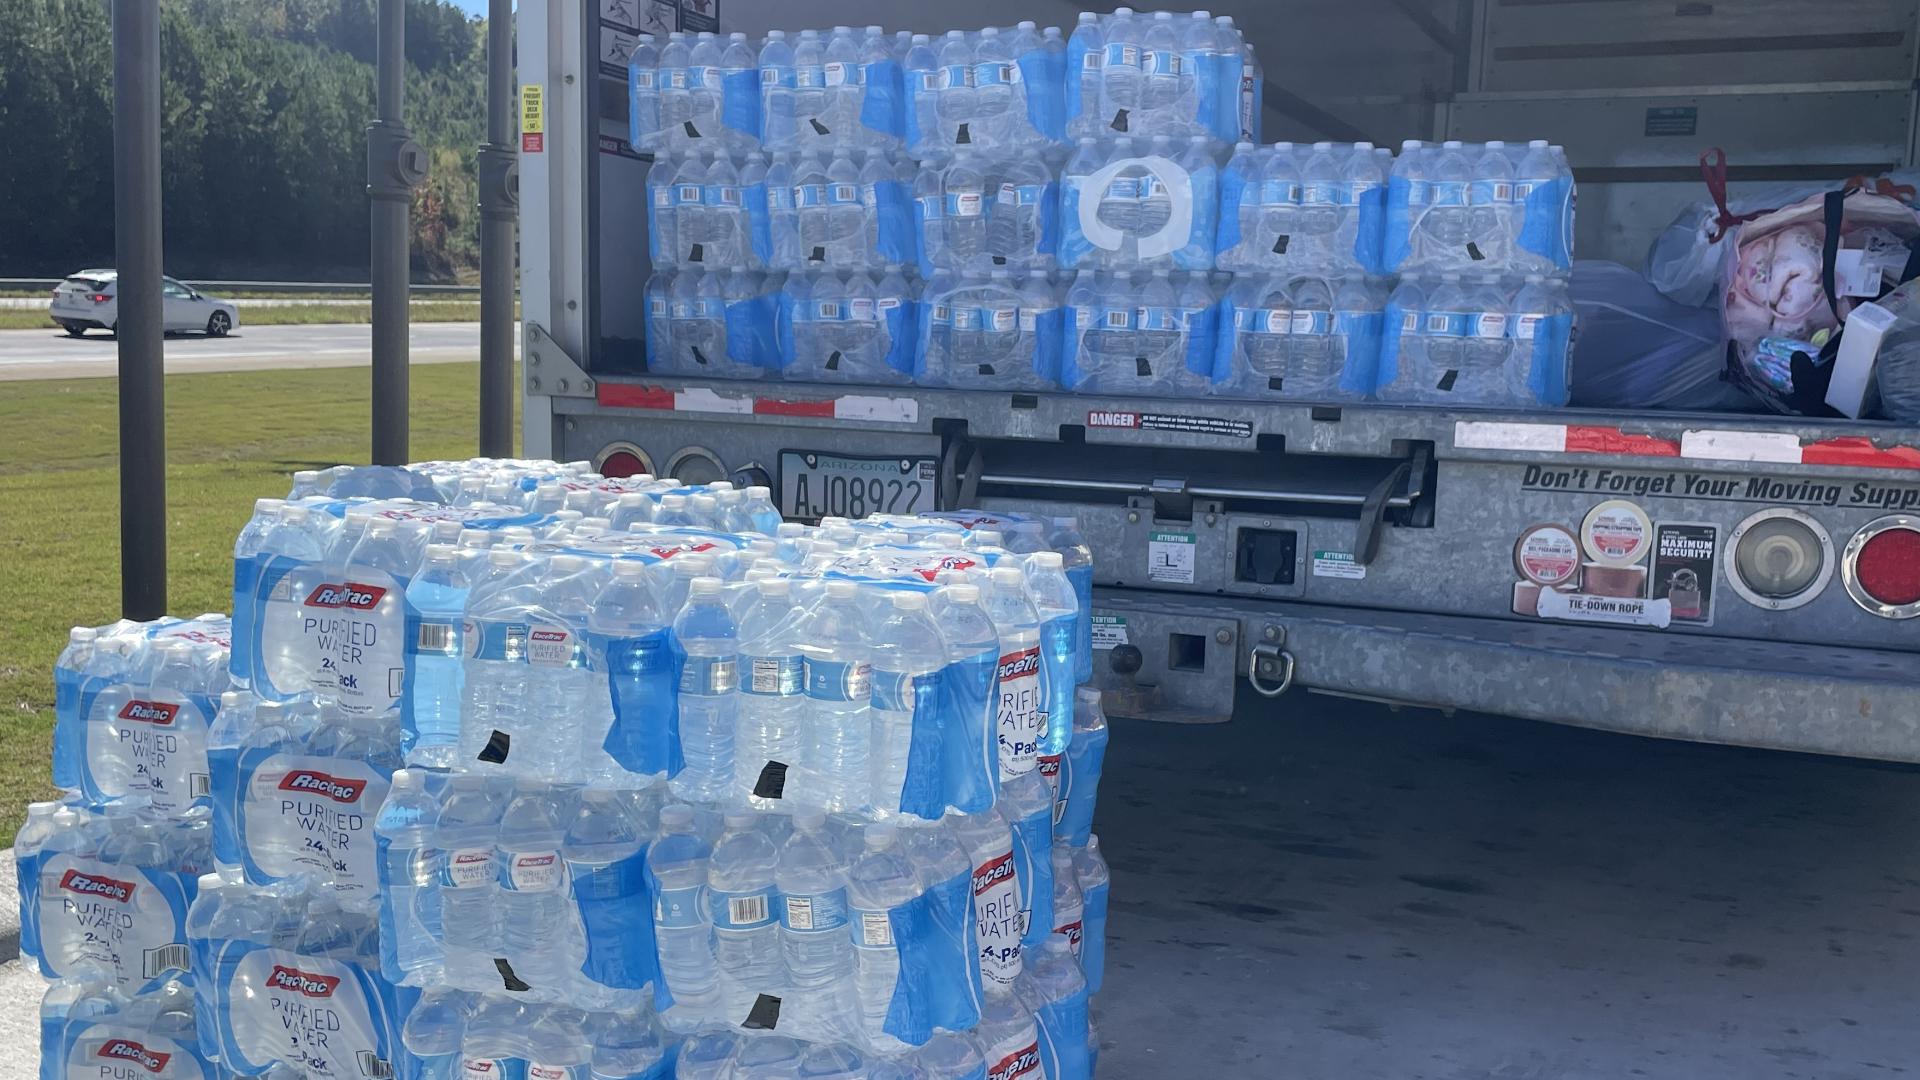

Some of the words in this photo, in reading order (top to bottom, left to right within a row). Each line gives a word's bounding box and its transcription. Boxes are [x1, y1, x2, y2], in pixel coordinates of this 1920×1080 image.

[1090, 412, 1135, 427] DANGER
[820, 460, 899, 472] ARIZONA
[1522, 464, 1589, 489] Don't
[1594, 470, 1676, 497] Forget
[1684, 474, 1740, 498] Your
[1745, 477, 1842, 506] Moving
[1850, 482, 1920, 510] Supp
[795, 473, 922, 519] AJ08922
[1156, 534, 1189, 543] ATTENTION
[1661, 539, 1713, 549] MAXIMUM
[1323, 551, 1355, 560] ATTENTIO
[1660, 547, 1713, 558] SECURITY
[1569, 599, 1616, 612] TIE-DOWN
[1618, 603, 1644, 614] ROPE
